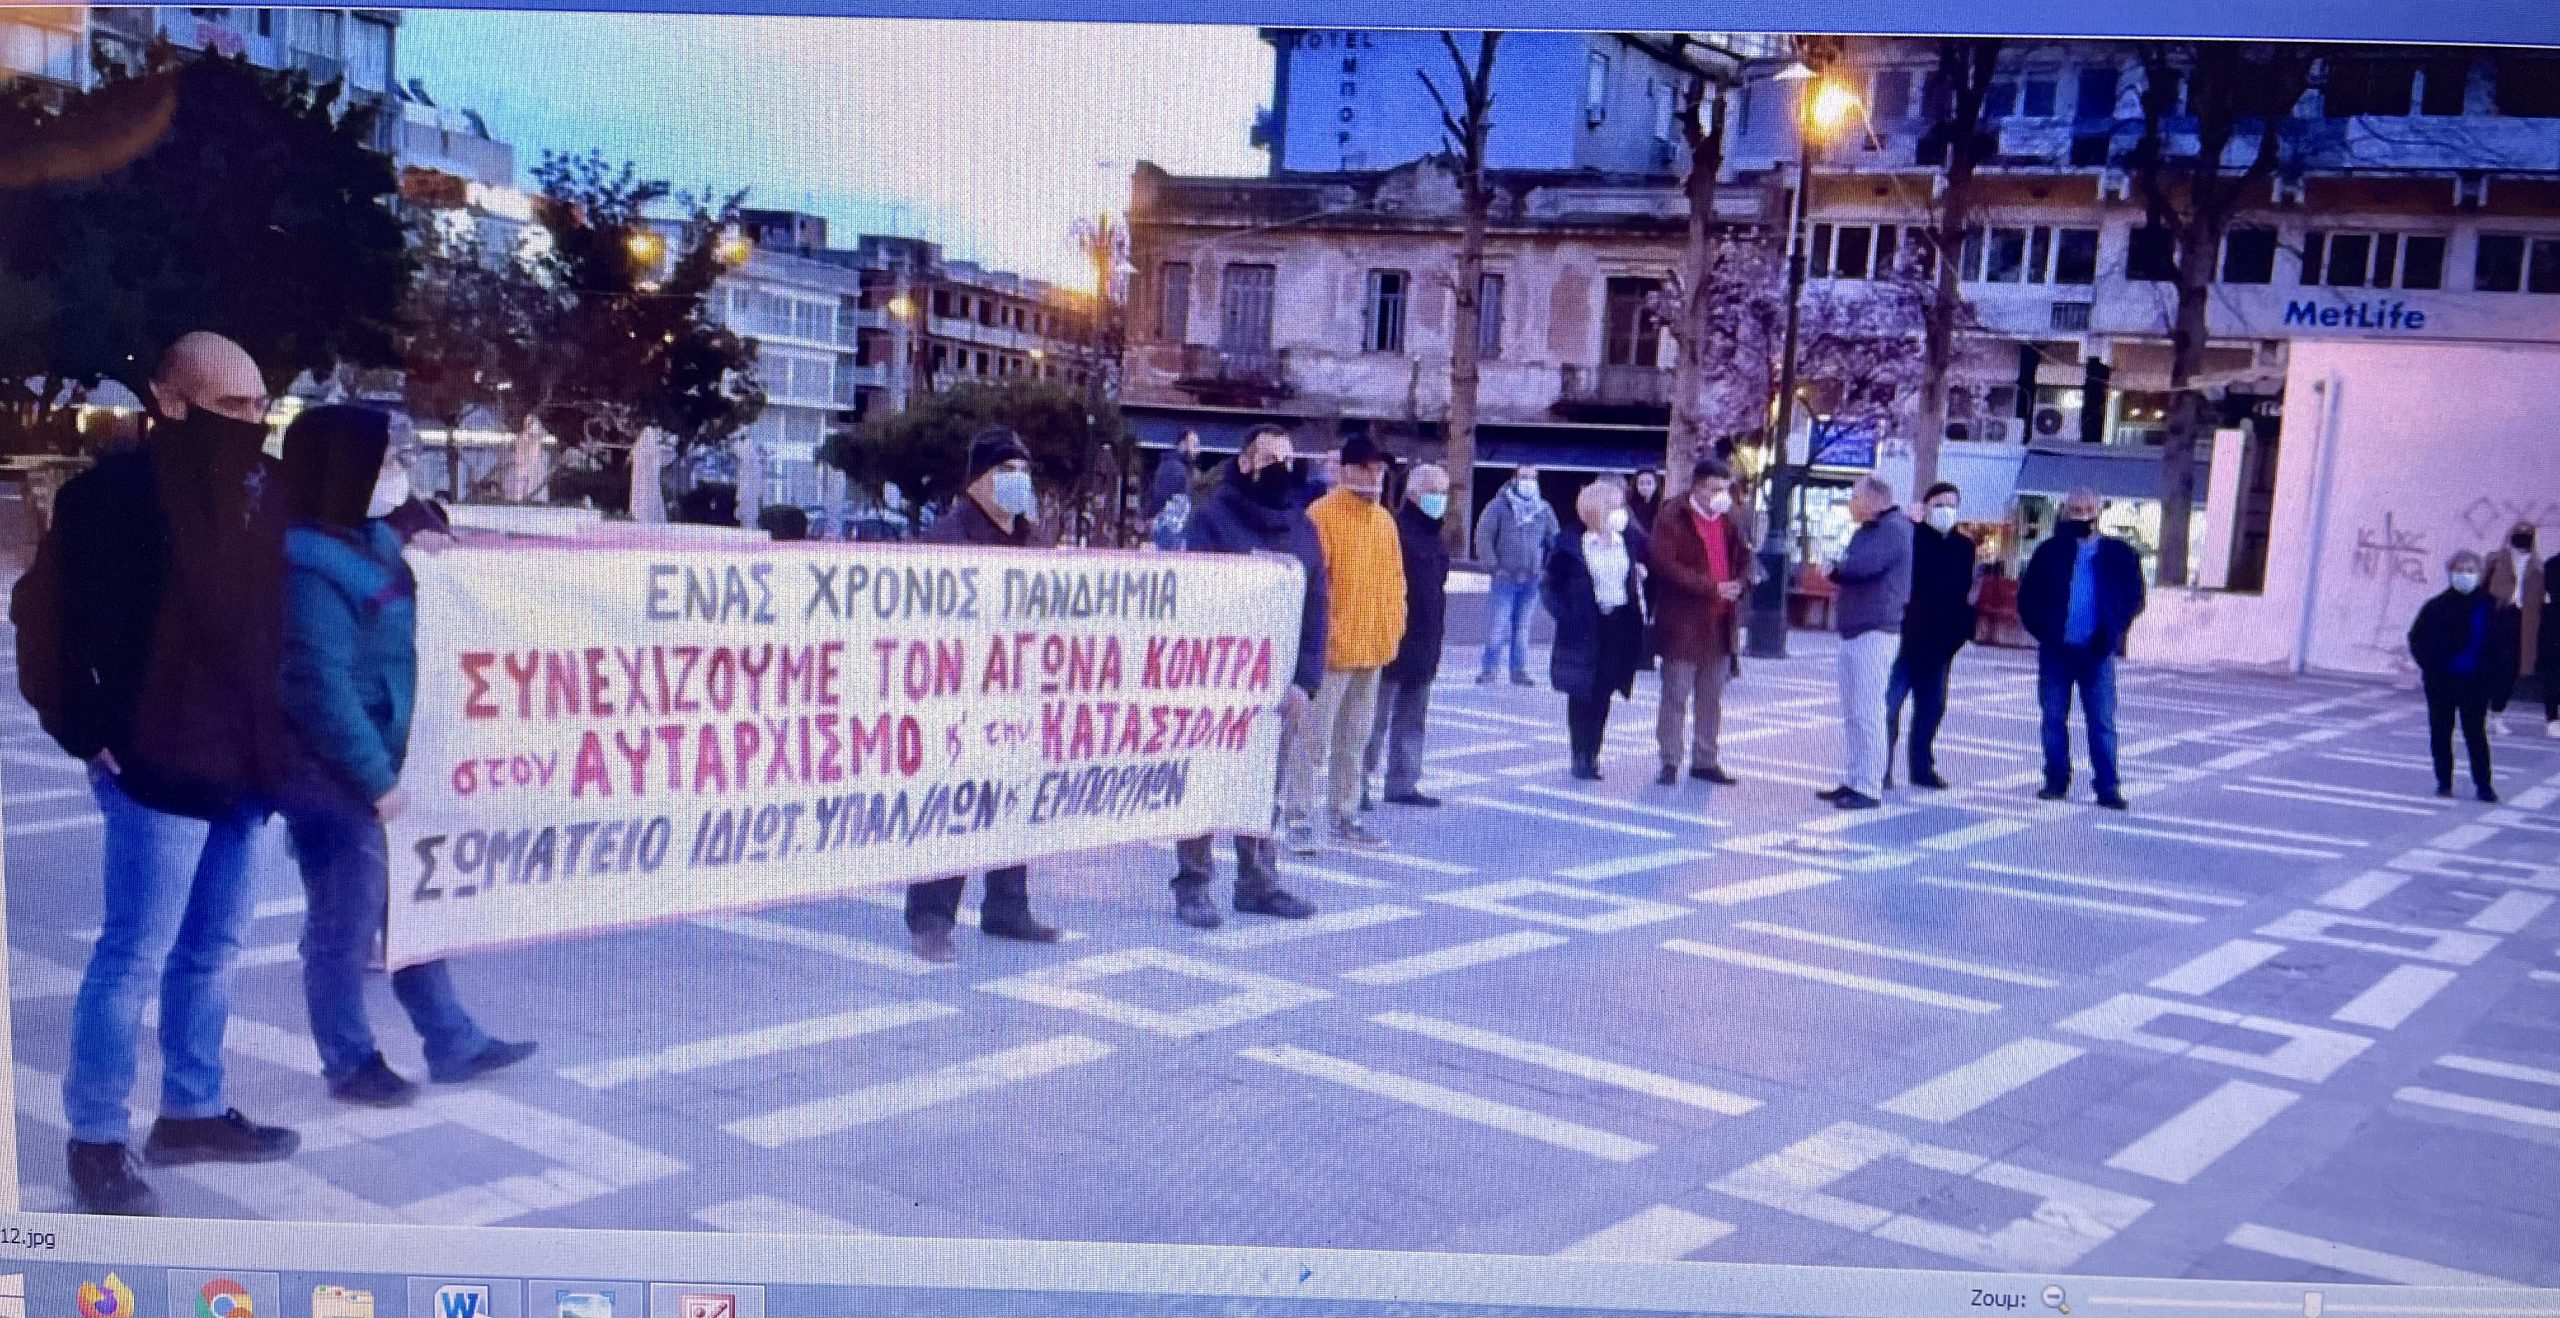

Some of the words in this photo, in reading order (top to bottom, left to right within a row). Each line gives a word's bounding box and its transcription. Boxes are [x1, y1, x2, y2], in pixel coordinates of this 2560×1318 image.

[2284, 299, 2425, 329] MetLife
[646, 563, 774, 625] ΕΝΑΣ
[805, 562, 980, 621] ΧΡΟΝΟΣ
[1003, 567, 1178, 622] ΠΑΝΔΗΜΙΑ
[460, 641, 844, 720] ΣΥΝΕΧΙΖΟΥΜΕ
[874, 637, 964, 702] ΤΟΝ
[982, 633, 1122, 694] ΑΓΩΝΑ
[1141, 635, 1272, 691] ΚΟΝΤΡΑ
[452, 750, 558, 797] στον
[570, 712, 923, 798] ΑΥΤΑΡΧΙΣΜΟ
[984, 716, 1033, 753] την
[1042, 700, 1262, 763] ΚΑΤΑΣΤΟΛΗ
[413, 814, 673, 902] ΣΩΜΑΤΕΙΟ
[688, 801, 805, 868] ΙΔΙΩΤ.
[1, 1227, 56, 1249] 12.jpg
[1970, 1288, 2026, 1311] Ζουμ:
